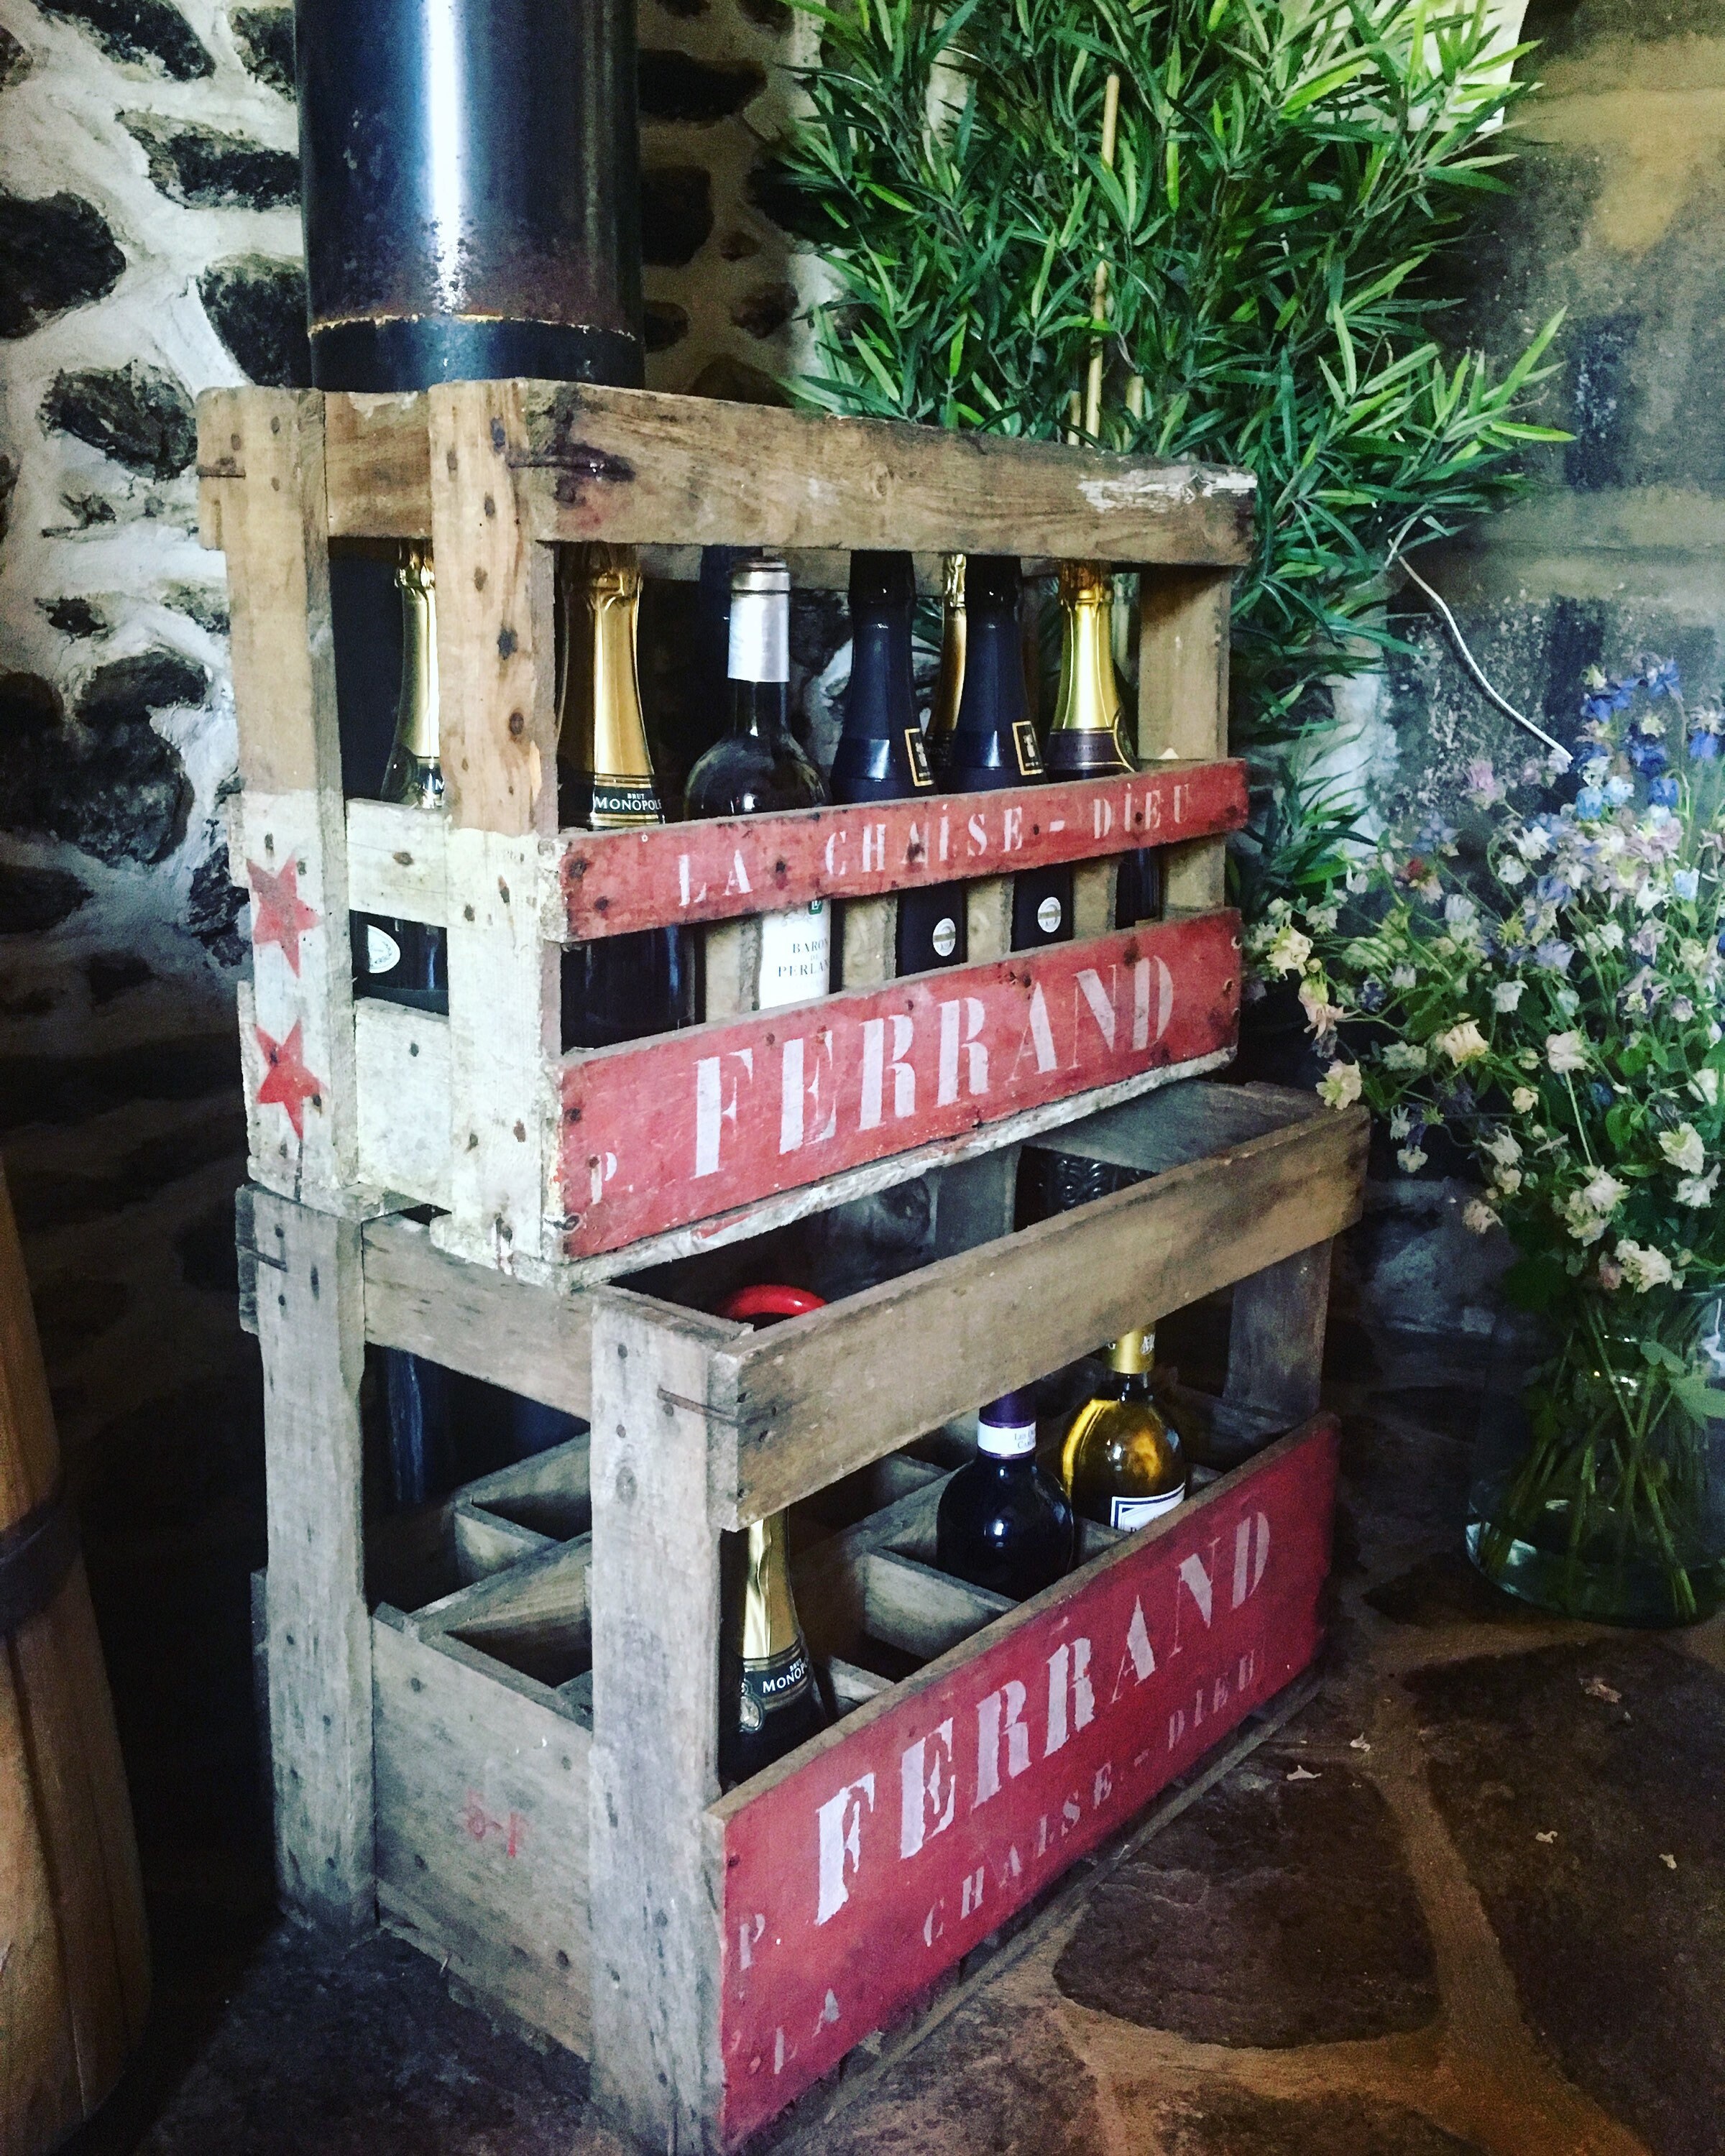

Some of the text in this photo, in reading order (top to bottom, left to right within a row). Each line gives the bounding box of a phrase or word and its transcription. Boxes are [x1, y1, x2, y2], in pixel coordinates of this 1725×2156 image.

[594, 796, 661, 811] MONOPOLE
[678, 849, 753, 907] LA
[825, 803, 1023, 876] CHAISE
[1093, 783, 1190, 839] DIEU
[694, 956, 1174, 1179] FERRAND
[814, 1511, 1271, 1926] FERRAND
[924, 1761, 1112, 1948] CHAISE
